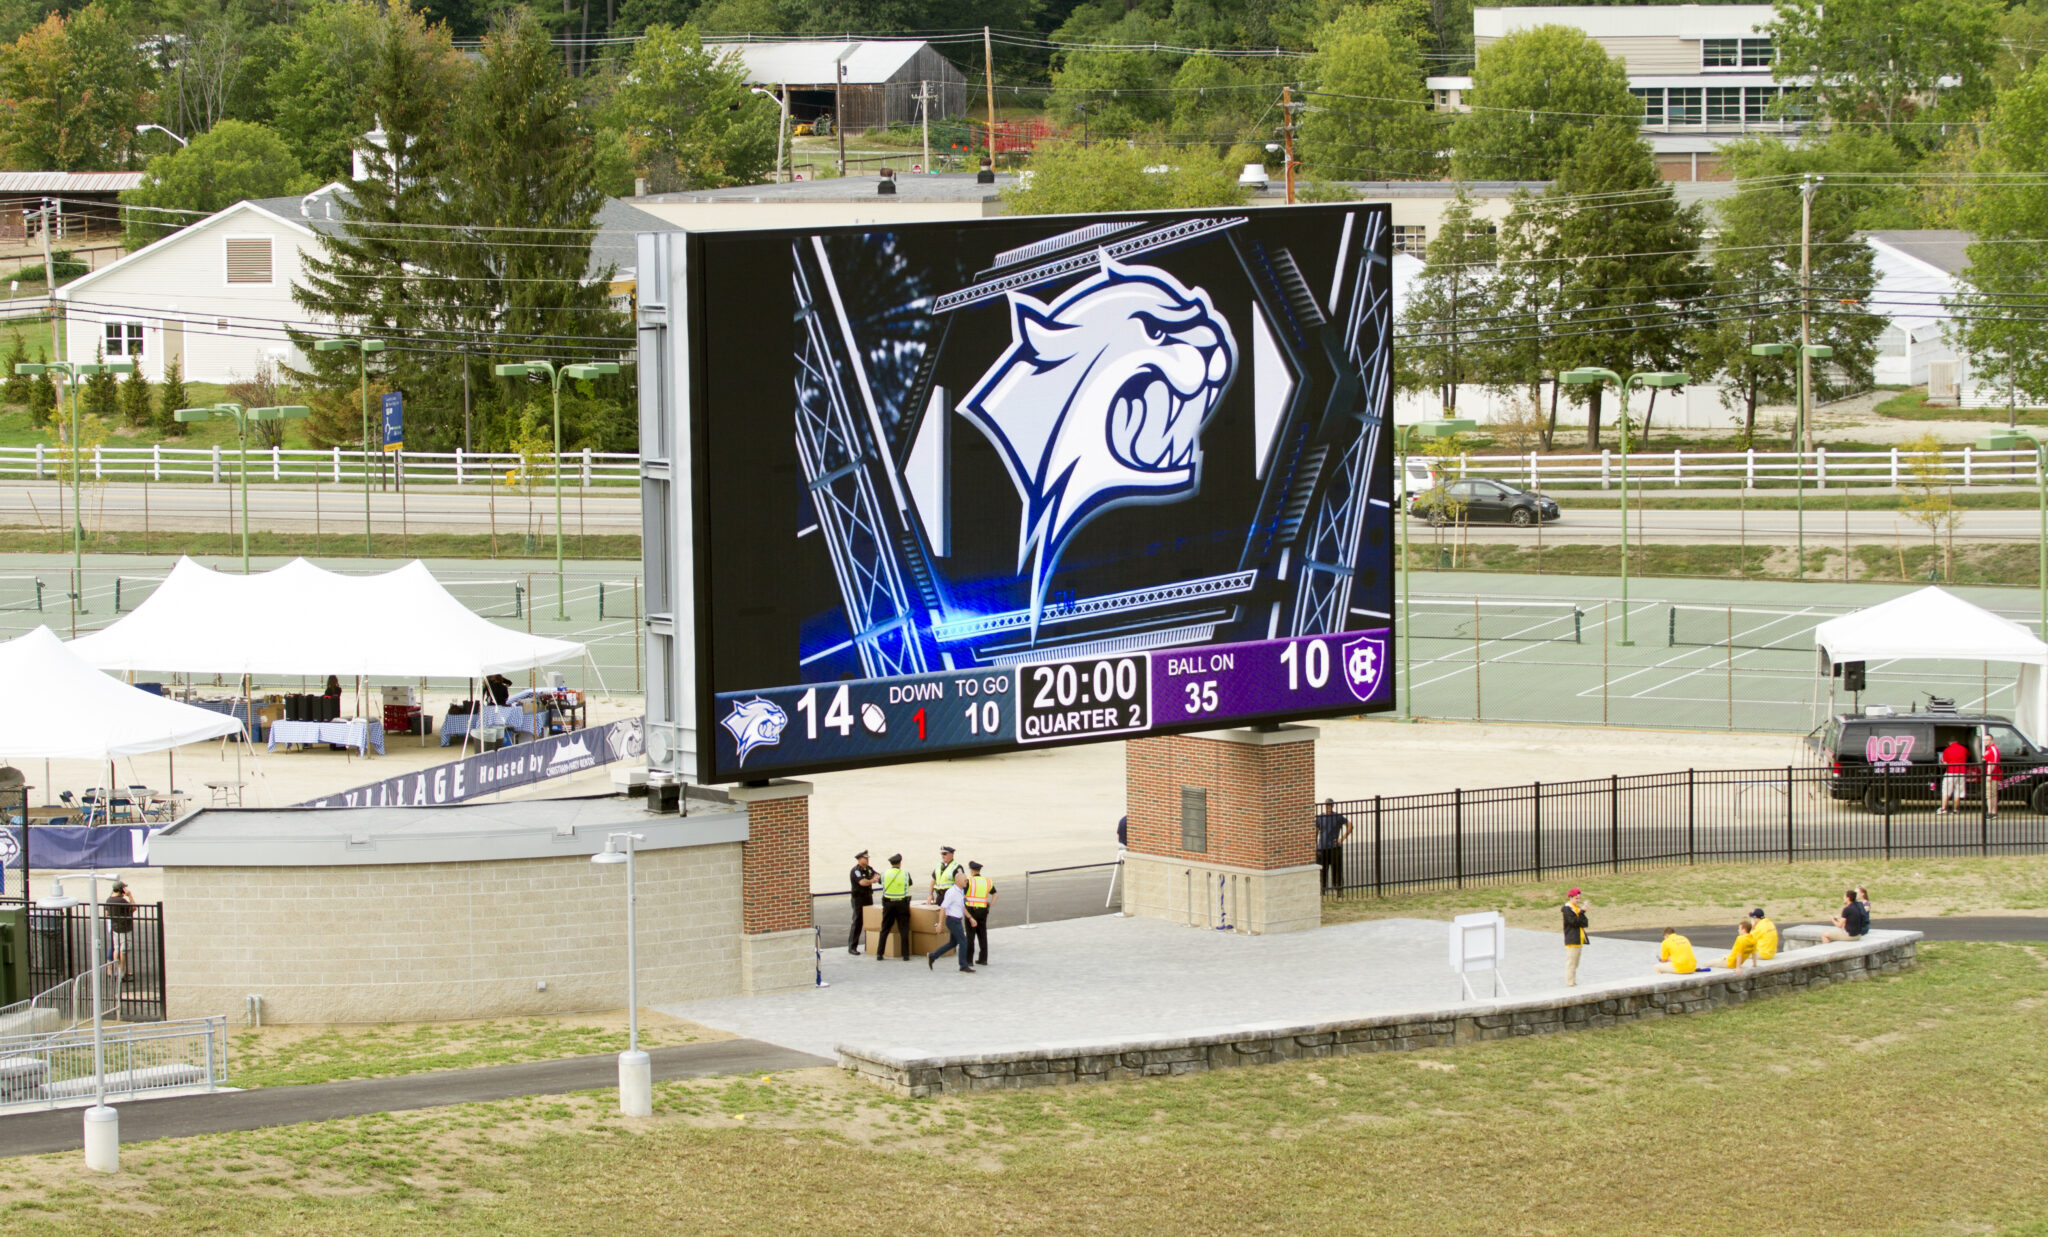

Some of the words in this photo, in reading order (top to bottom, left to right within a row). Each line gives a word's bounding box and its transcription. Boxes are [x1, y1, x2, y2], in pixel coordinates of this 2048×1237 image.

[1168, 656, 1207, 676] BALL
[1210, 653, 1234, 672] ON
[1280, 639, 1330, 690] 10
[889, 682, 943, 704] DOWN
[955, 679, 978, 697] TO
[983, 676, 1009, 694] GO
[1033, 658, 1137, 708] 20:00
[1185, 680, 1218, 714] 35
[797, 684, 854, 739] 14
[912, 707, 926, 739] 1
[964, 700, 1000, 734] 10
[1025, 708, 1118, 736] QUARTER
[1128, 704, 1141, 727] 2
[479, 756, 524, 784] Housed
[529, 754, 544, 773] by
